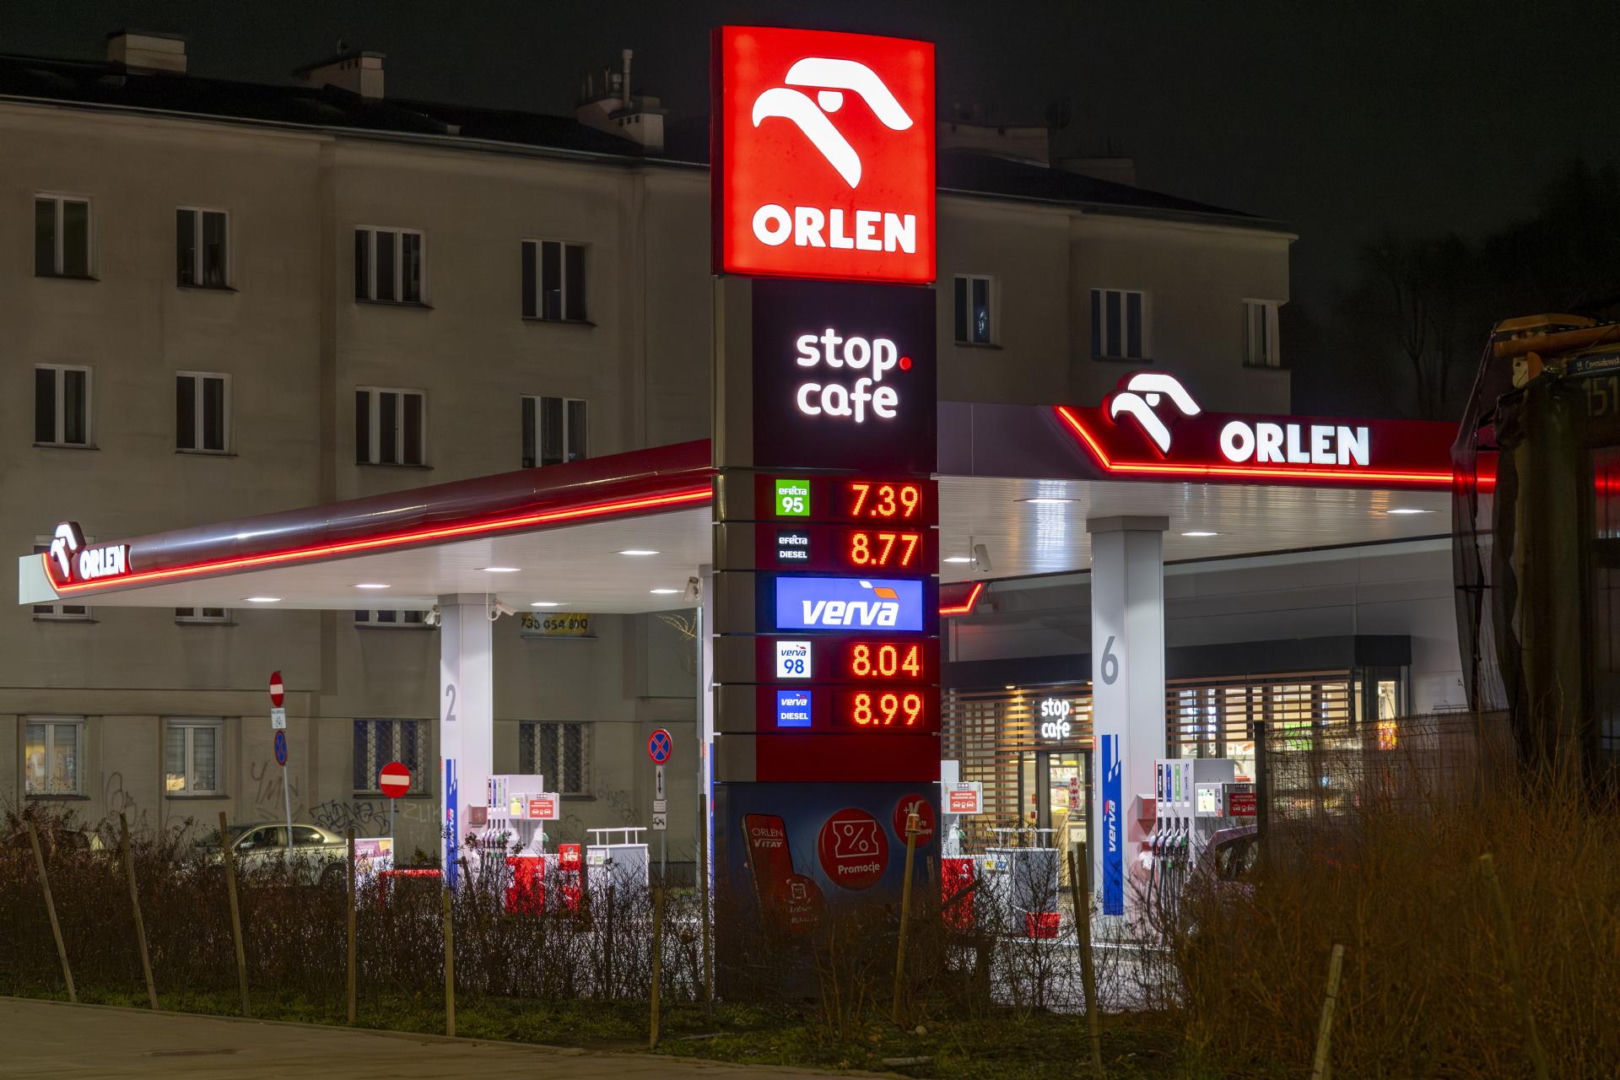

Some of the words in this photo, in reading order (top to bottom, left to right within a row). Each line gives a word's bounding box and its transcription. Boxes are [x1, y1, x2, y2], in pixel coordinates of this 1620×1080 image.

[752, 204, 916, 254] ORLEN
[796, 377, 899, 423] cafe
[1219, 420, 1370, 466] ORLEN
[782, 497, 804, 513] 95
[852, 484, 918, 517] 7.39
[79, 545, 125, 579] ORLEN
[779, 551, 808, 559] DIESEL
[852, 533, 918, 566] 8.77
[802, 600, 899, 626] verva
[781, 648, 806, 657] verva
[784, 659, 804, 674] 98
[853, 644, 919, 677] 8.04
[1101, 635, 1119, 685] 6
[446, 684, 457, 722] 2
[780, 712, 808, 720] DIESEL
[781, 698, 807, 706] verva
[854, 693, 921, 725] 8.99
[1041, 718, 1071, 740] cafe
[751, 827, 783, 838] ORLEN
[1108, 799, 1117, 852] verva
[838, 861, 881, 875] Promocje
